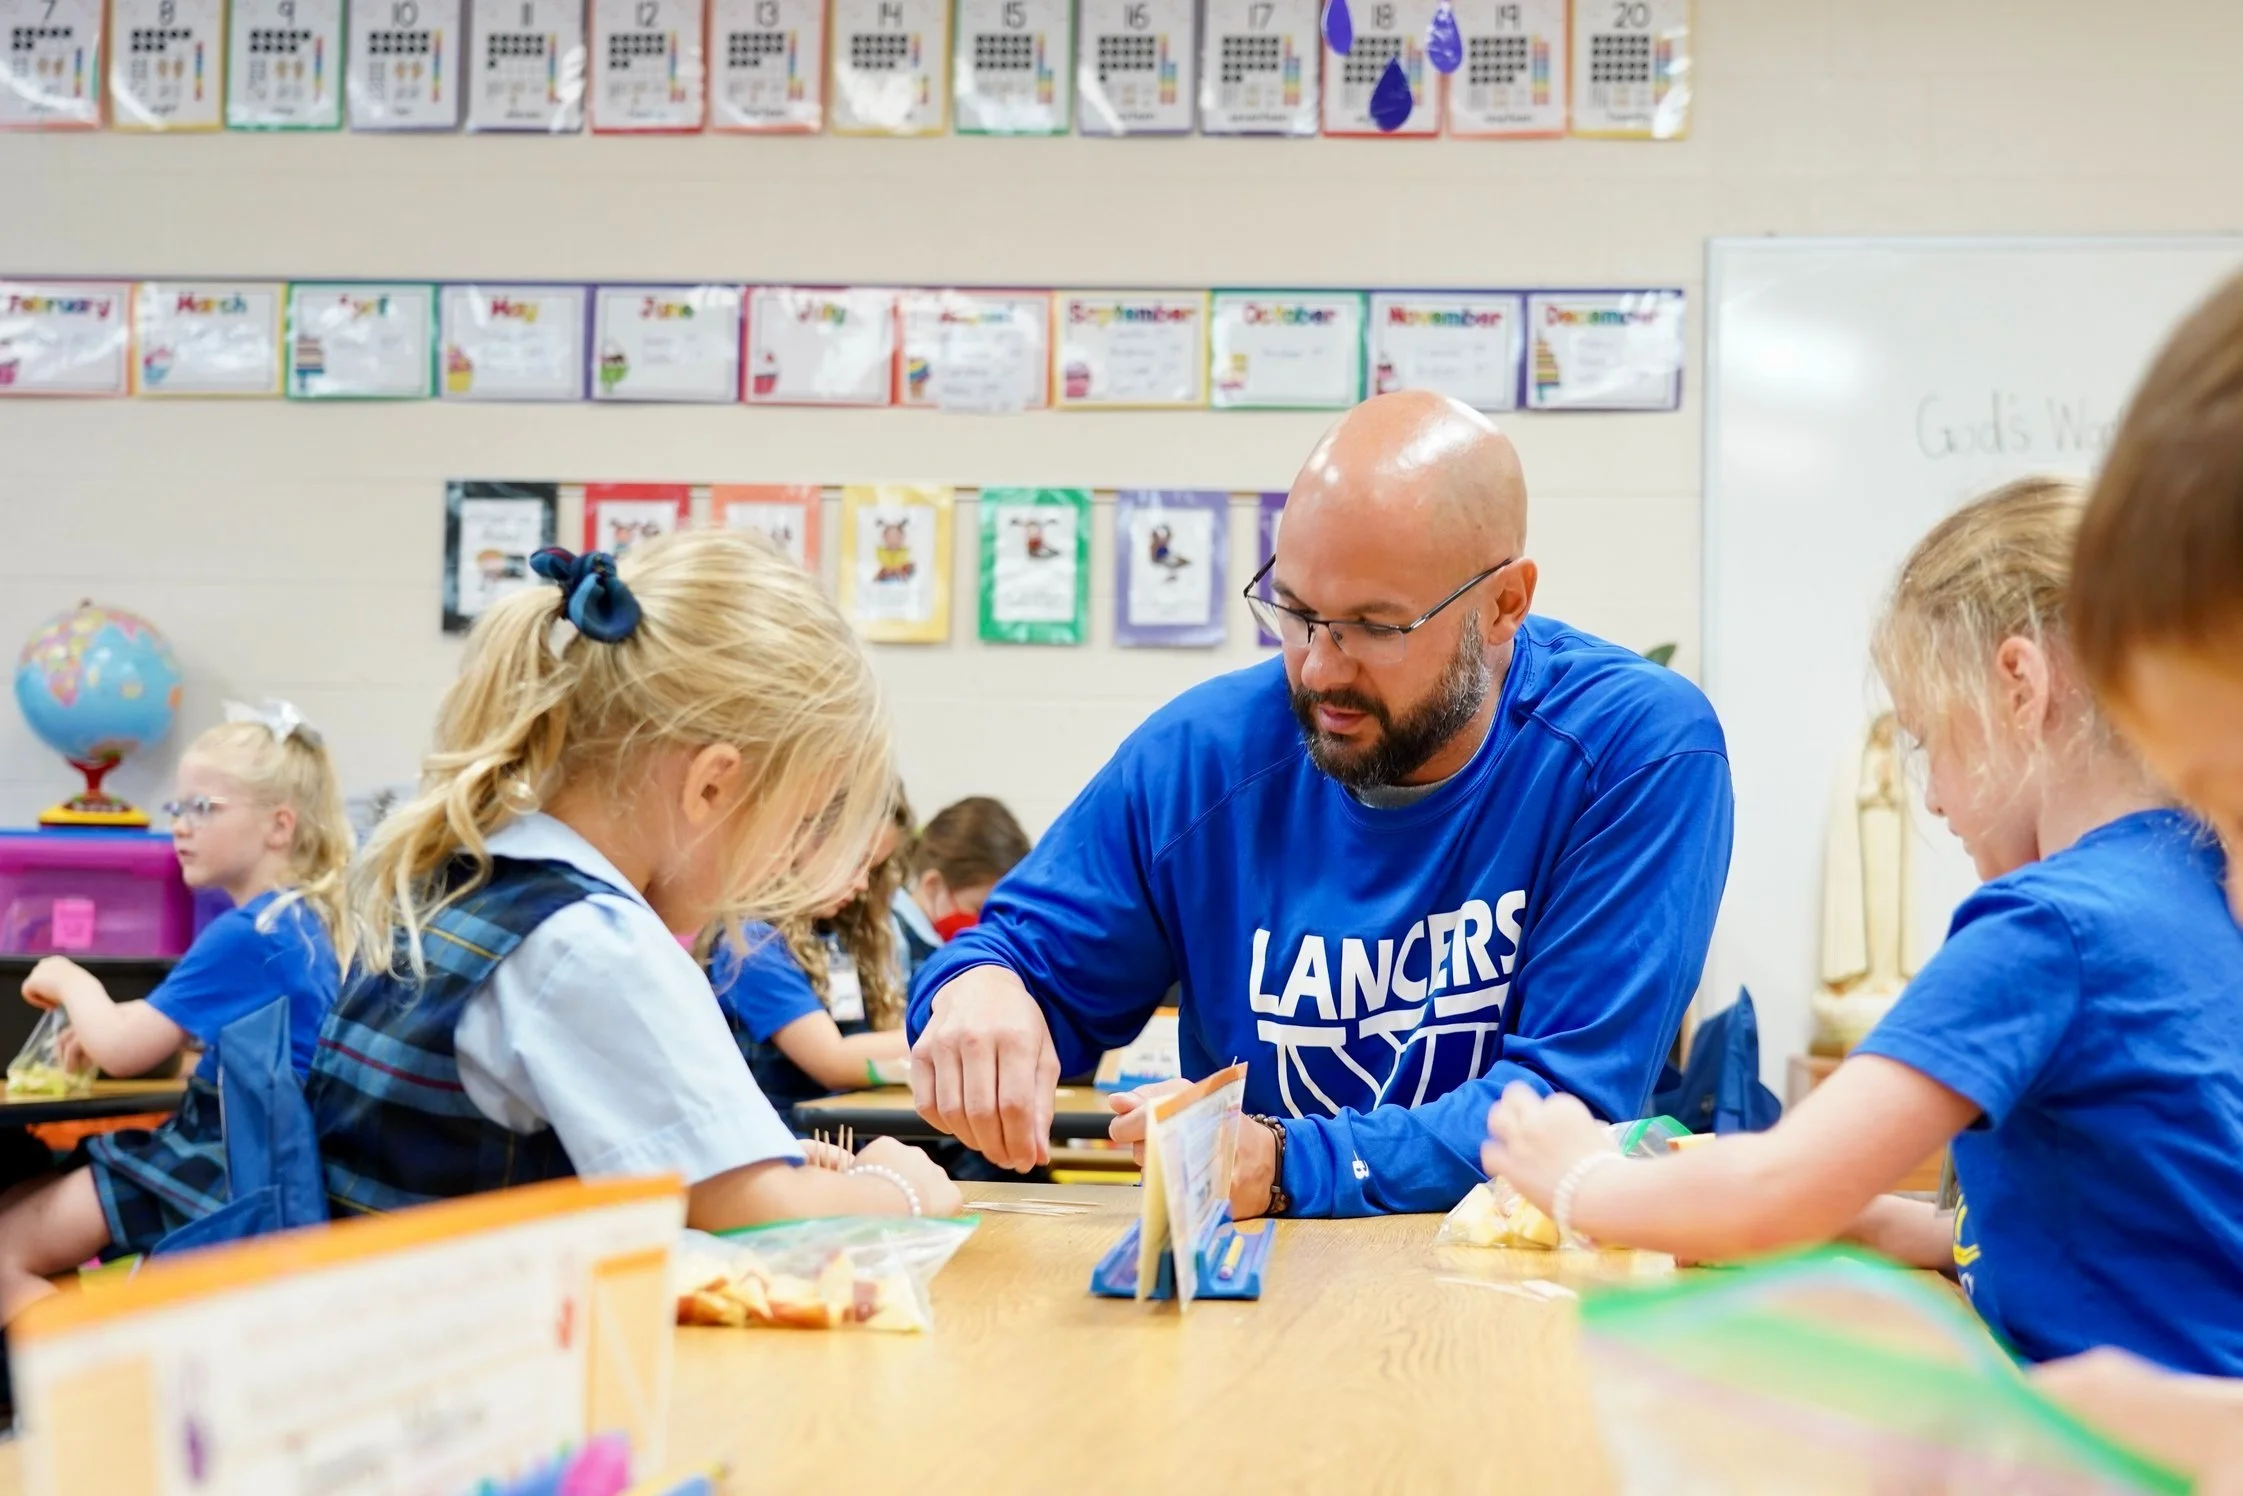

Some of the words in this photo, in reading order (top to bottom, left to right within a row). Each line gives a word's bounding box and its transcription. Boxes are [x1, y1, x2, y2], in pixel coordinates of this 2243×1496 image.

[40, 0, 57, 21] 7
[157, 0, 175, 25] 8
[276, 0, 296, 26] 9
[390, 2, 418, 27] 10
[520, 3, 533, 27] 11
[635, 3, 659, 28] 12
[754, 2, 780, 28] 13
[878, 3, 903, 28] 14
[1001, 2, 1027, 29] 15
[1124, 3, 1150, 30] 16
[1248, 3, 1275, 30] 17
[1371, 3, 1396, 30] 18
[1495, 4, 1521, 30] 19
[1613, 2, 1651, 30] 20
[491, 297, 538, 321] May
[1388, 305, 1502, 328] November
[1250, 890, 1526, 1020] LANCERS
